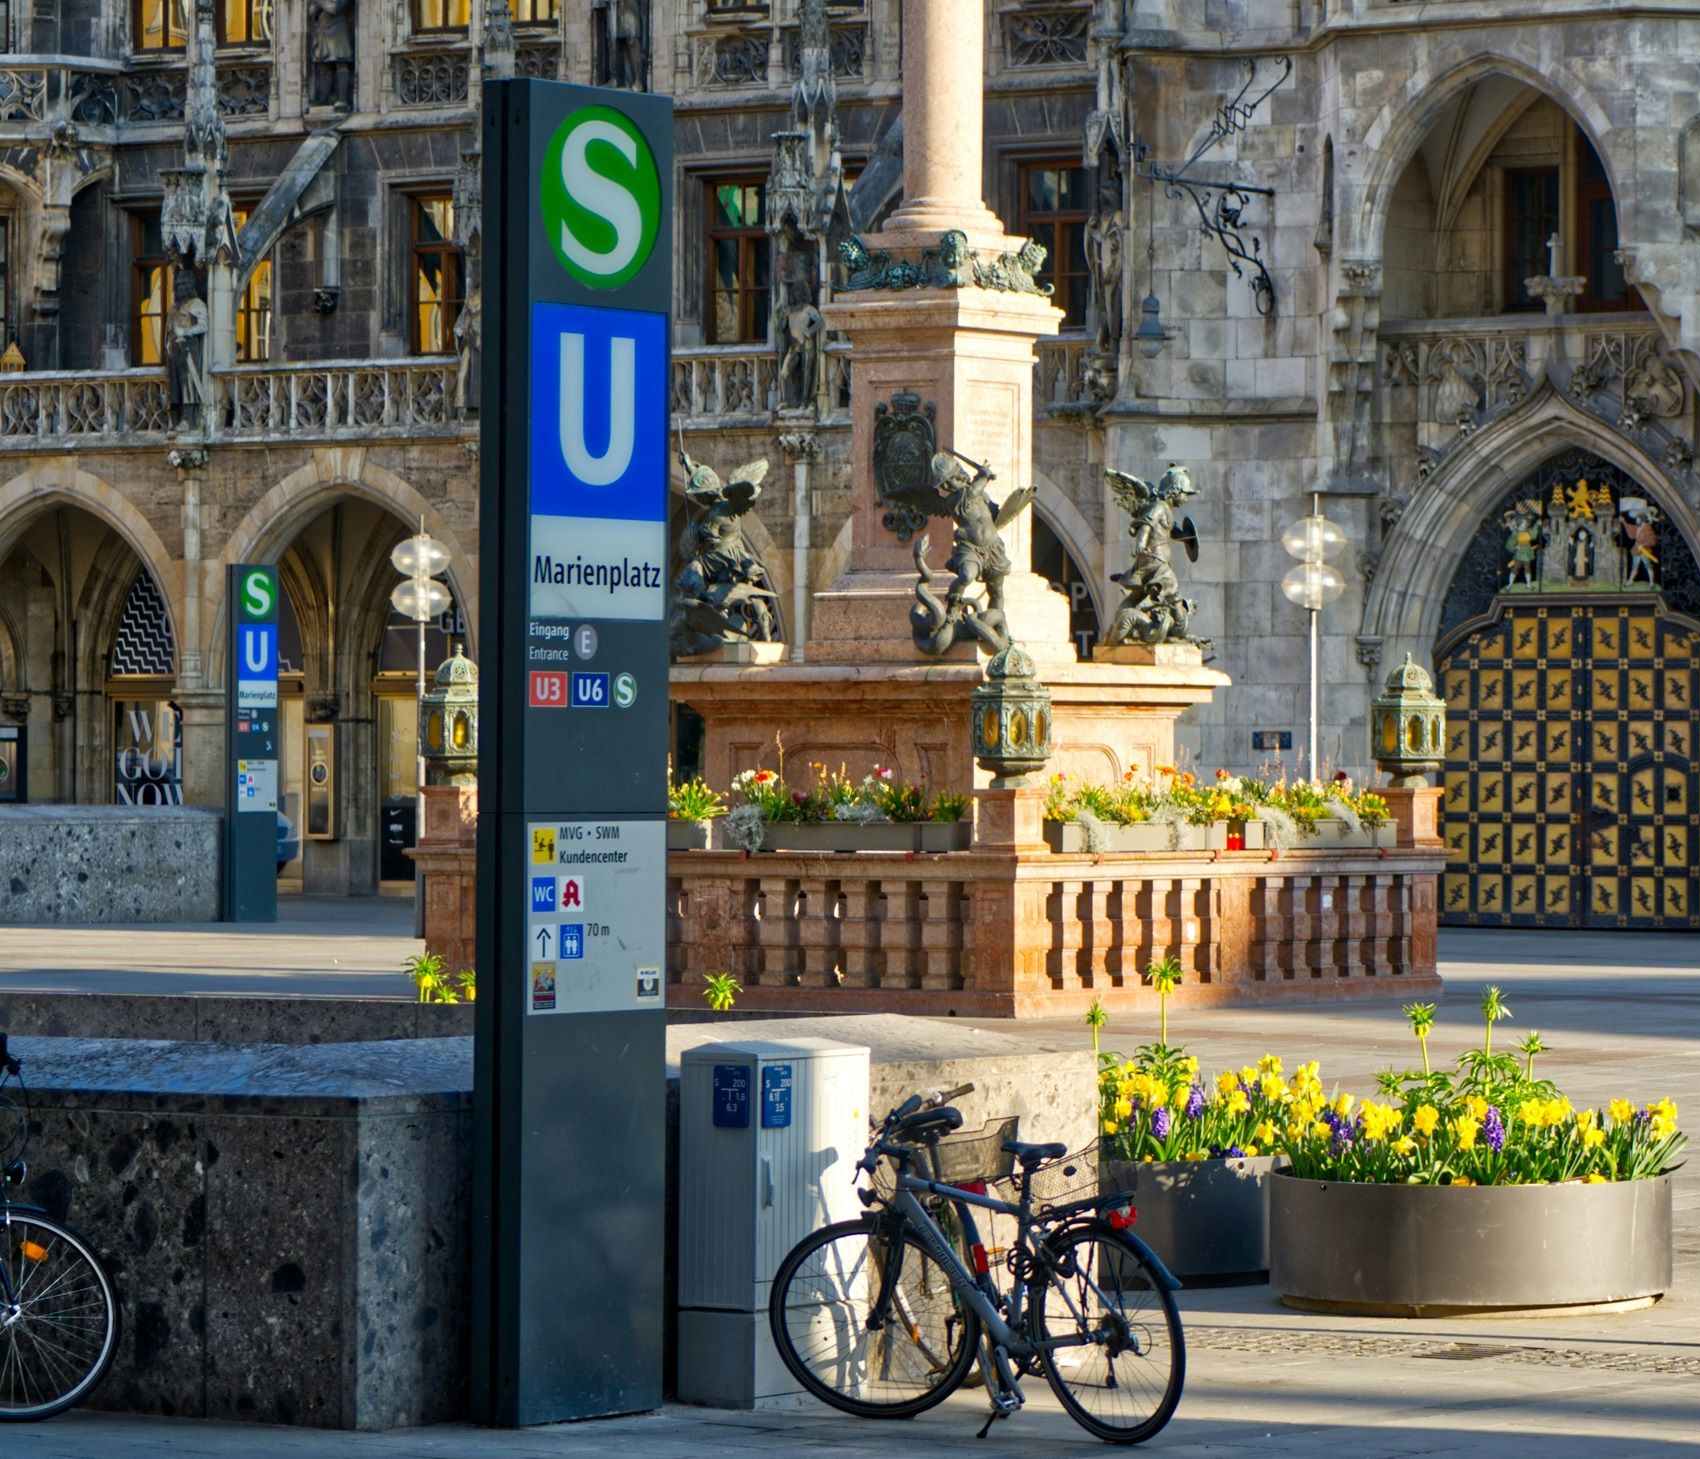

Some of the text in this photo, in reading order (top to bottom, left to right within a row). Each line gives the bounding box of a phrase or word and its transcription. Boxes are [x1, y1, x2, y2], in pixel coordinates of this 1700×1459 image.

[561, 119, 643, 276] S
[559, 331, 636, 487] U
[534, 555, 661, 594] Marienplatz
[246, 572, 271, 616] S
[529, 622, 570, 640] Eingang
[581, 631, 591, 653] E
[246, 630, 269, 673] U
[529, 646, 569, 660] Entrance
[239, 690, 276, 700] Marienplatz
[535, 675, 633, 705] U3 U6 S
[560, 825, 620, 840] MVG SWM
[560, 850, 628, 863] Kundencenter
[534, 886, 554, 902] WC
[587, 922, 610, 937] 70 m
[732, 1078, 746, 1088] 200
[780, 1078, 792, 1088] 200
